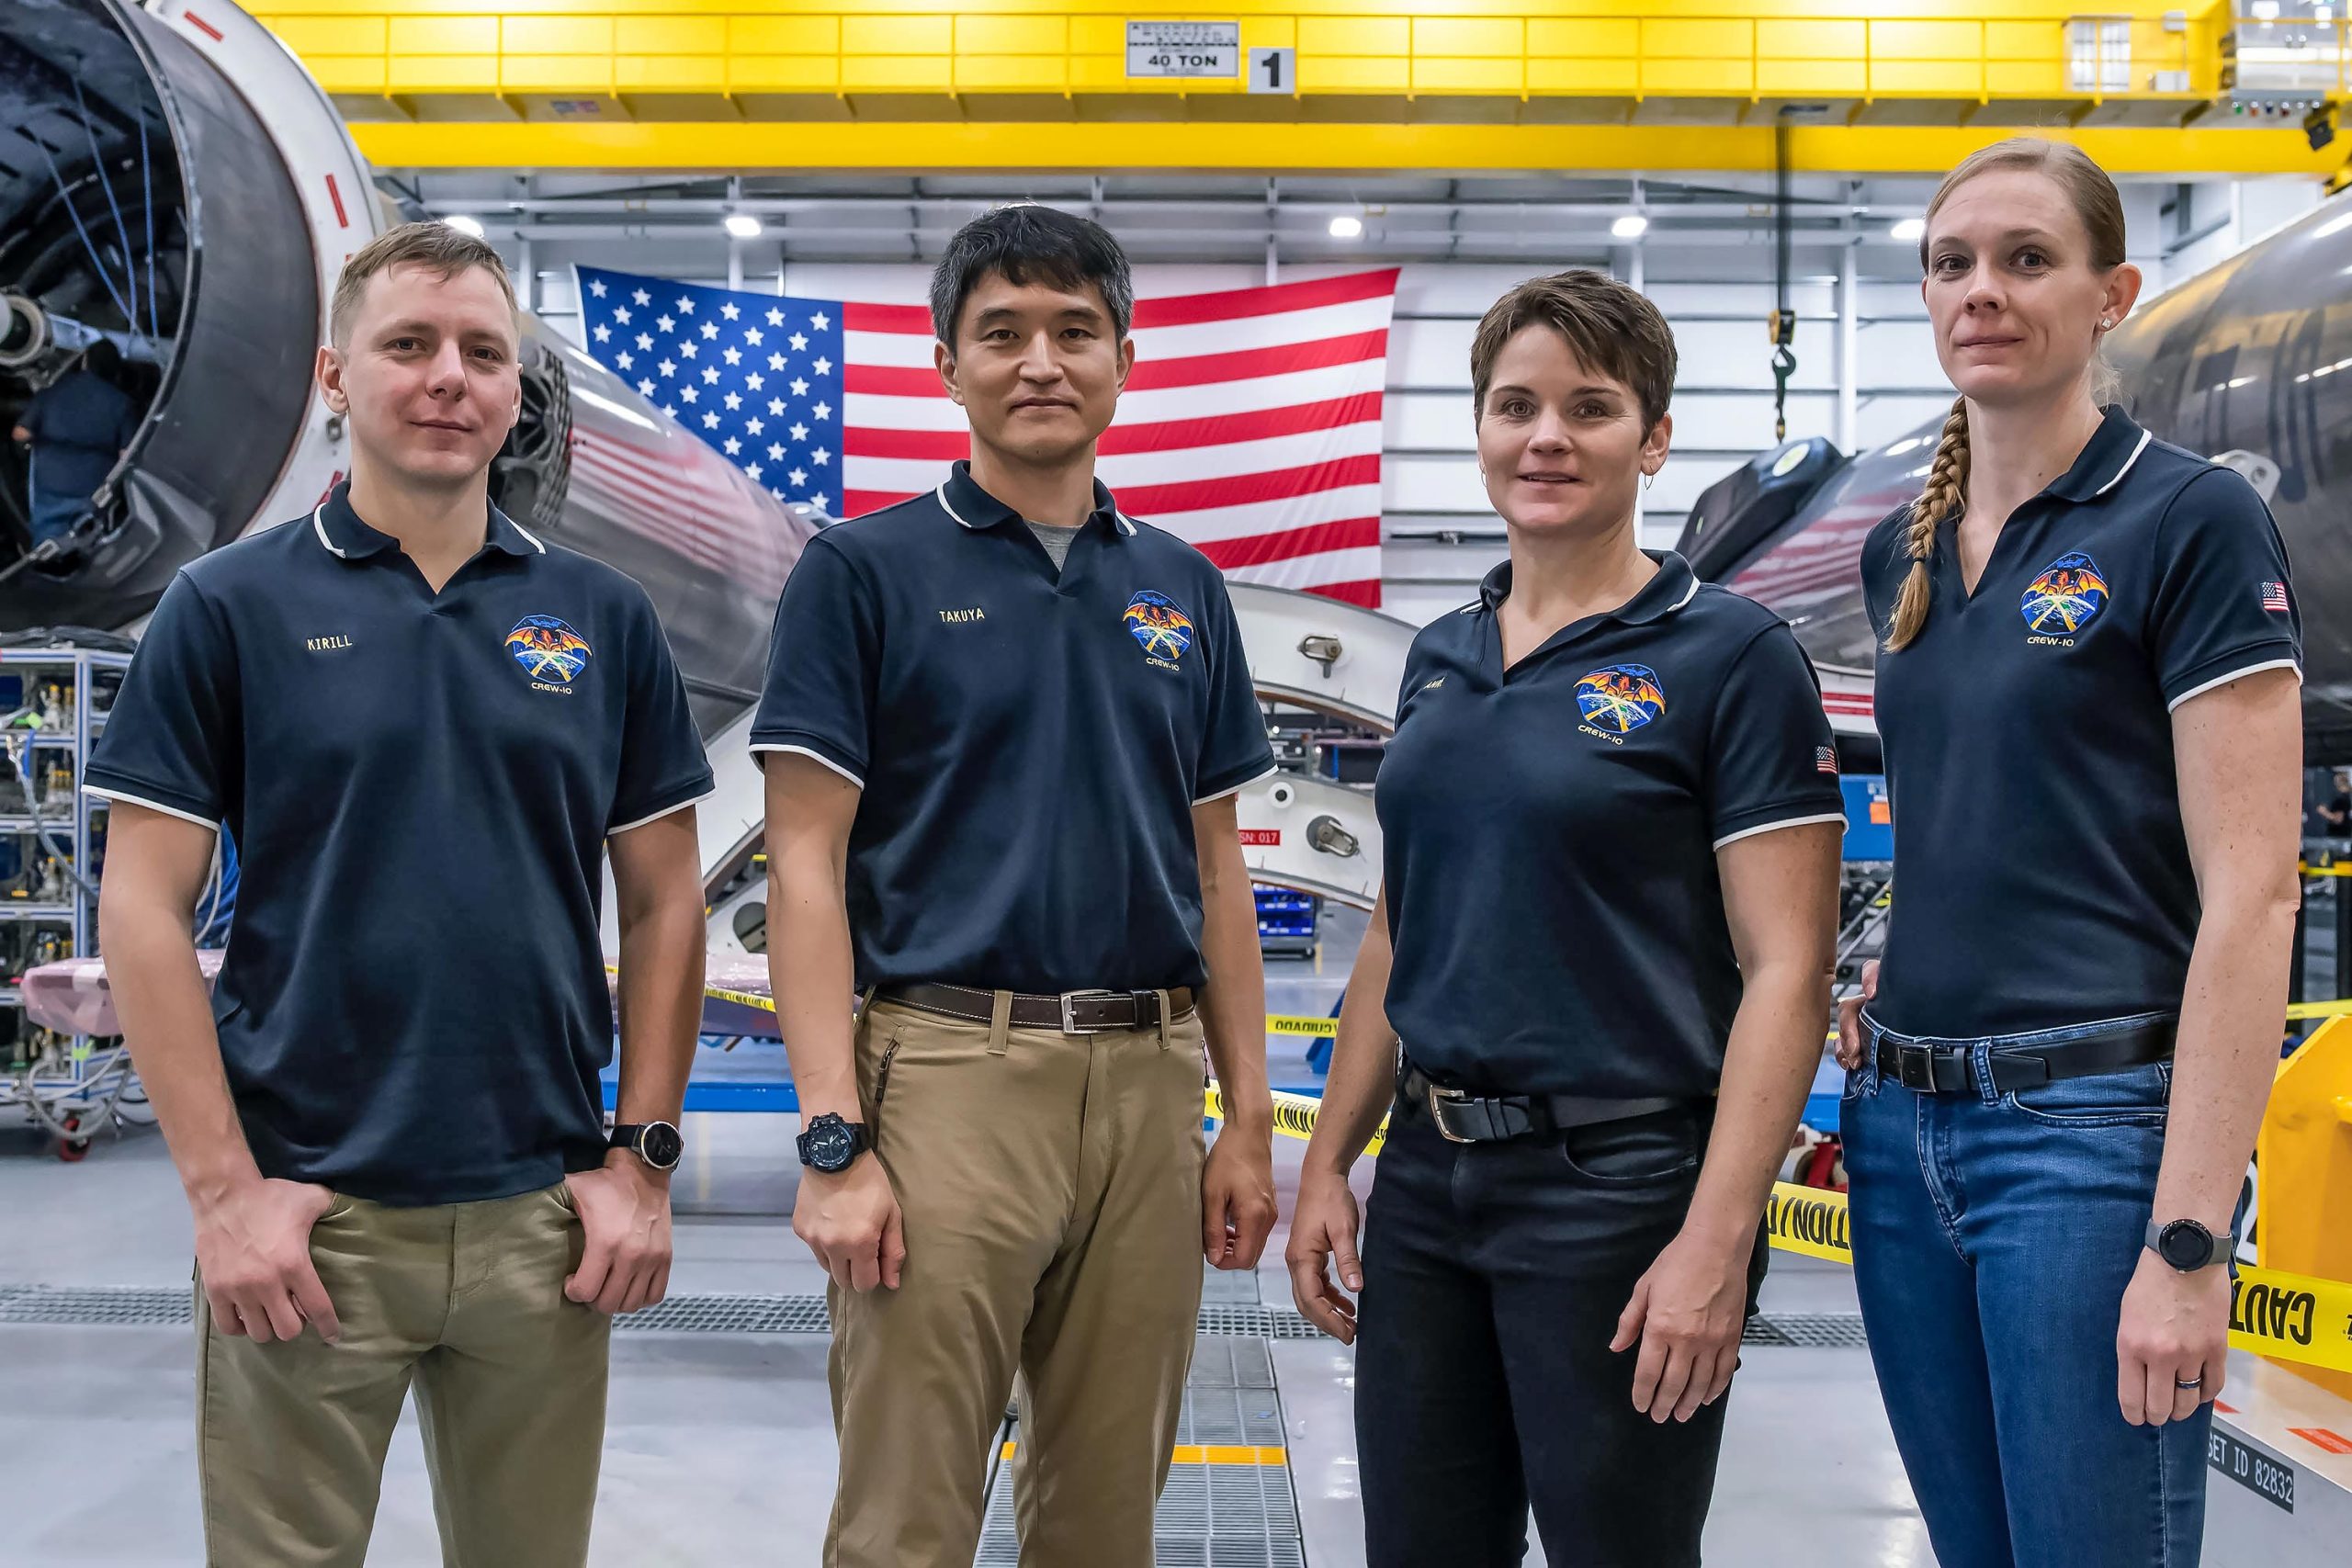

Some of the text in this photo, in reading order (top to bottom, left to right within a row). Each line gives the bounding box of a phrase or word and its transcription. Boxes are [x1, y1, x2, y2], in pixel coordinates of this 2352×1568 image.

[1148, 55, 1217, 67] 40 TON
[1261, 51, 1281, 88] 1
[939, 607, 985, 623] TAKUYA
[307, 634, 353, 650] KIRILL
[1258, 831, 1278, 844] 017
[2233, 1447, 2248, 1477] ID
[2255, 1461, 2293, 1505] 82832
